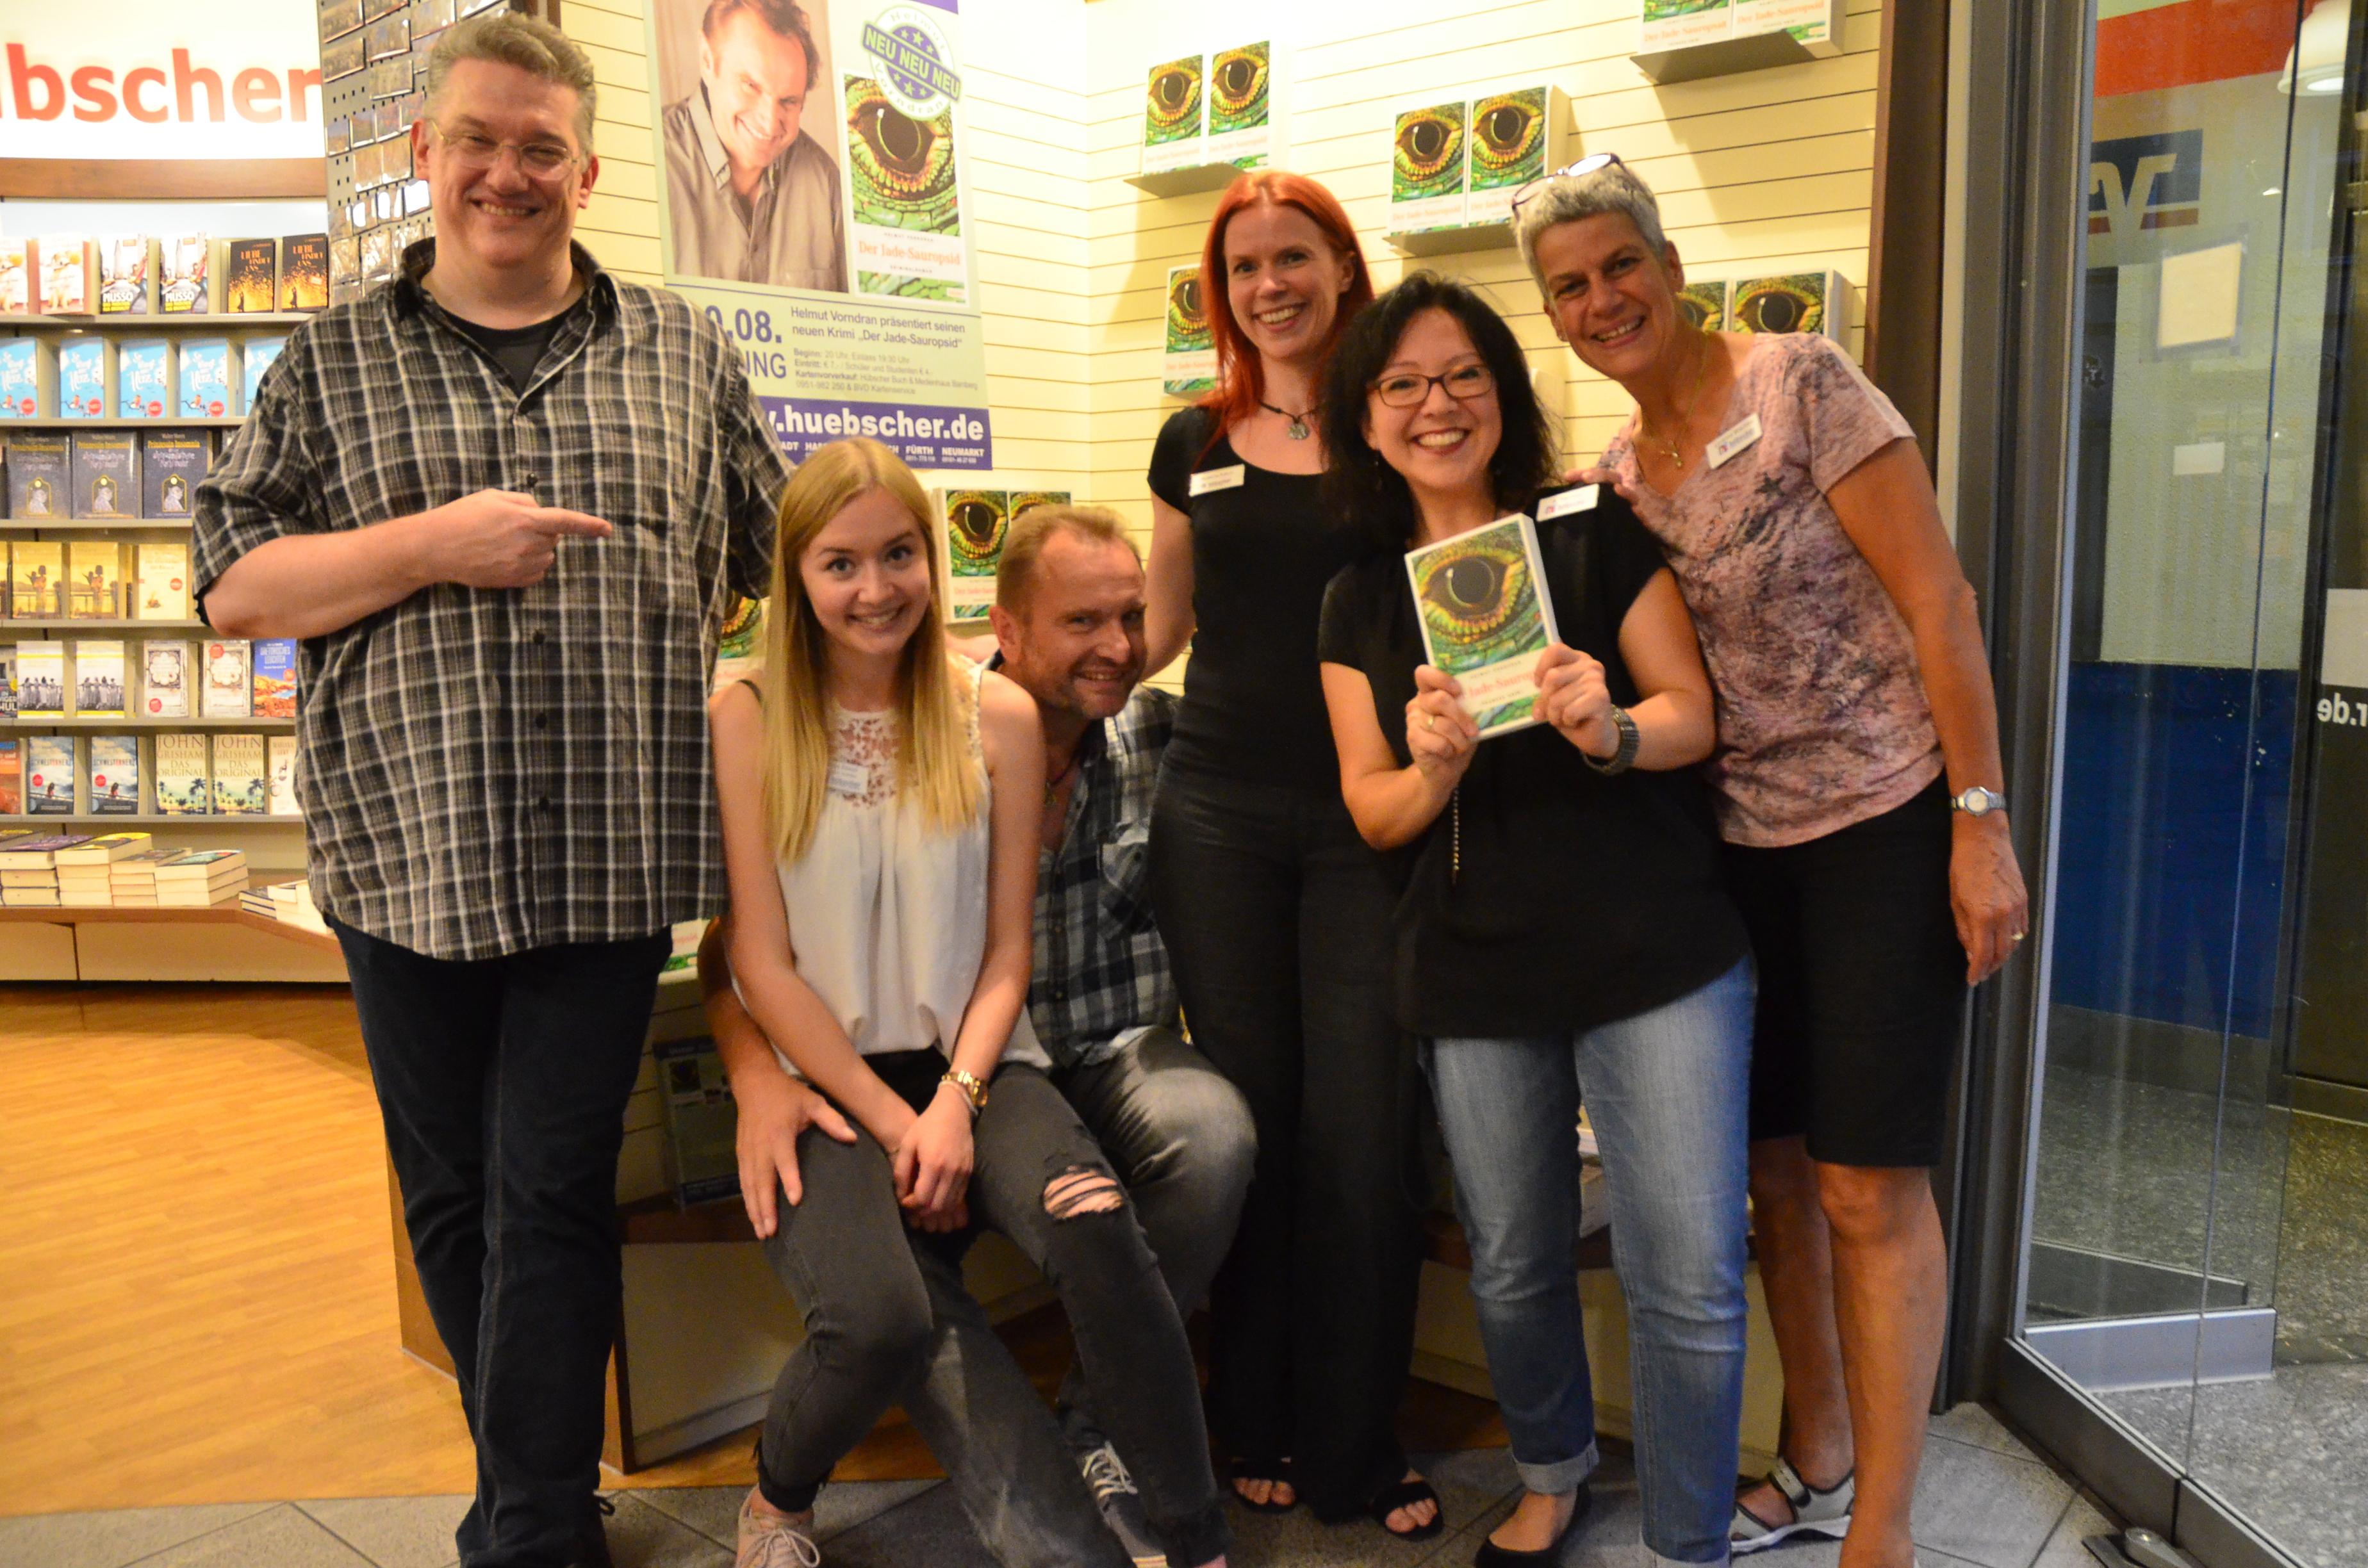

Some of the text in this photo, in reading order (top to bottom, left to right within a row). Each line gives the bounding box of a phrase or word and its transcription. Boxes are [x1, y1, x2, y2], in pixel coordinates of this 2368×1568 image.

[866, 27, 960, 99] NEU NEU NEU
[0, 43, 320, 124] bscher
[859, 241, 960, 266] Der Jade-Sauropsid
[103, 291, 133, 302] MUSSO
[165, 291, 194, 302] MUSSO
[791, 307, 965, 332] Helmut Vorndran präsentiert seinen
[793, 325, 824, 336] neuen
[827, 327, 855, 339] Krimi
[780, 441, 800, 451] ADT
[906, 444, 933, 455] FÜRTH
[942, 447, 985, 457] NEUMARKT
[157, 735, 203, 749] JOHN
[216, 735, 262, 749] JOHN
[157, 751, 203, 759] GRISHAM
[215, 751, 261, 759] GRISHAM
[157, 768, 204, 777] ORIGINAL
[215, 768, 262, 777] ORIGINAL
